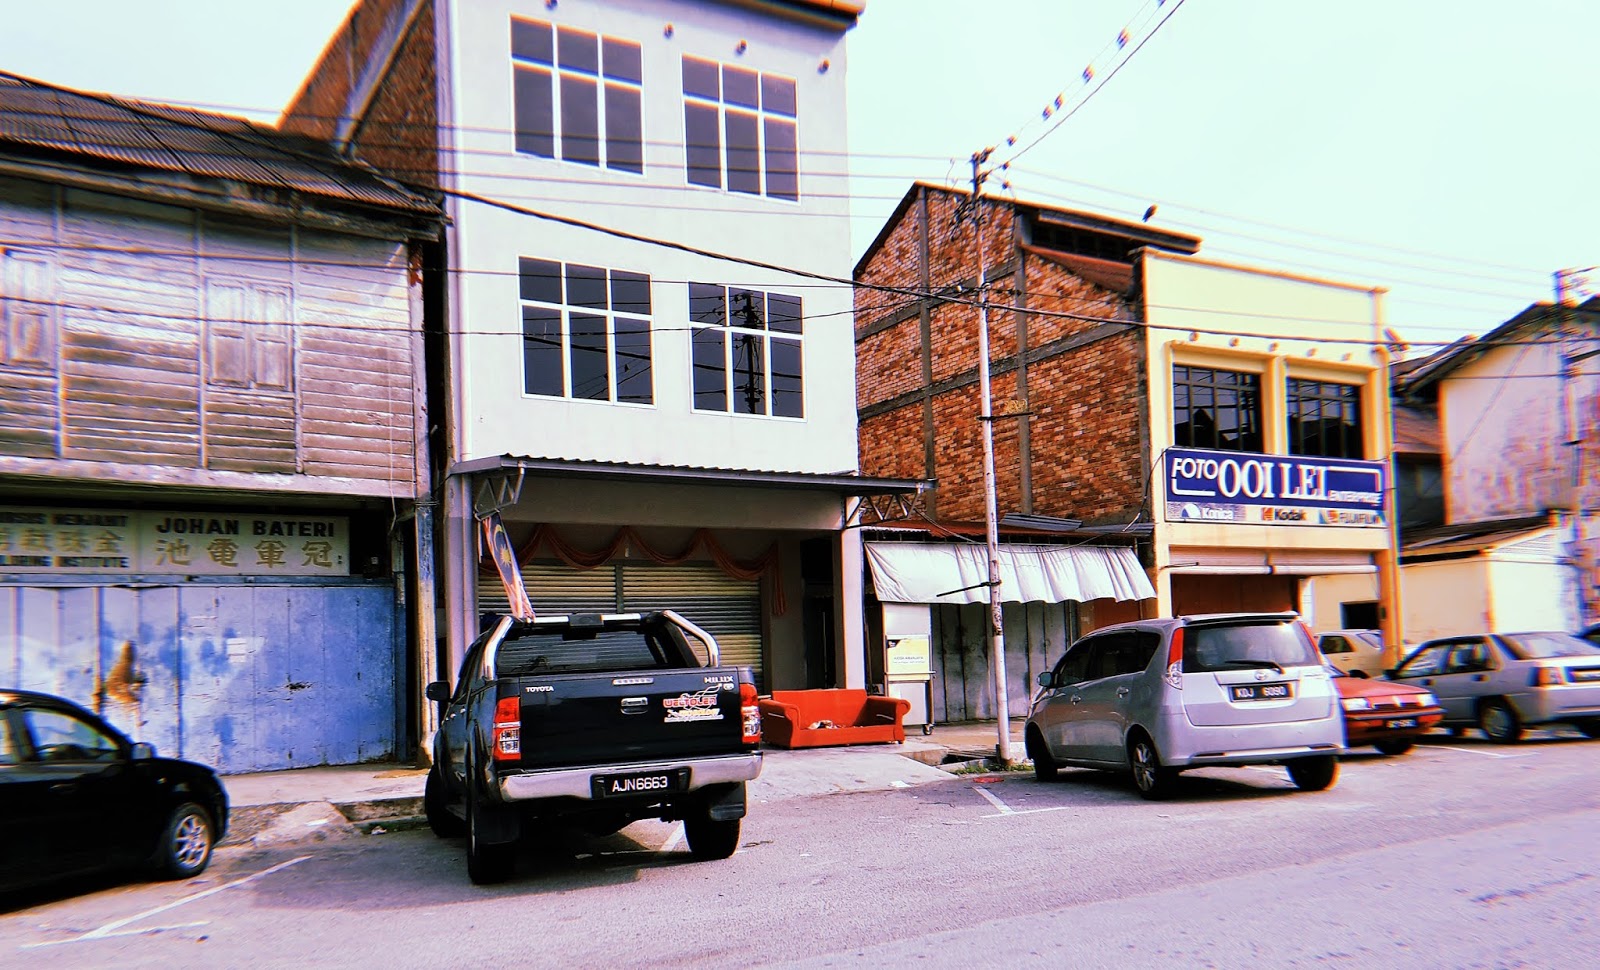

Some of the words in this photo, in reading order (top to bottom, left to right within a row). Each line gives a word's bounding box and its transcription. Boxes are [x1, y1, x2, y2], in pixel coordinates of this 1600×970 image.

[1171, 457, 1219, 480] FOTO
[1217, 458, 1274, 498] OOI
[1279, 463, 1328, 501] LEI
[1202, 508, 1234, 520] Konica
[1274, 509, 1306, 522] Kodak
[156, 517, 239, 535] JOHAN
[253, 520, 334, 537] BATERI
[54, 557, 129, 568] INSTITUTE
[704, 675, 734, 684] HILUX
[612, 775, 669, 793] AJN6663
